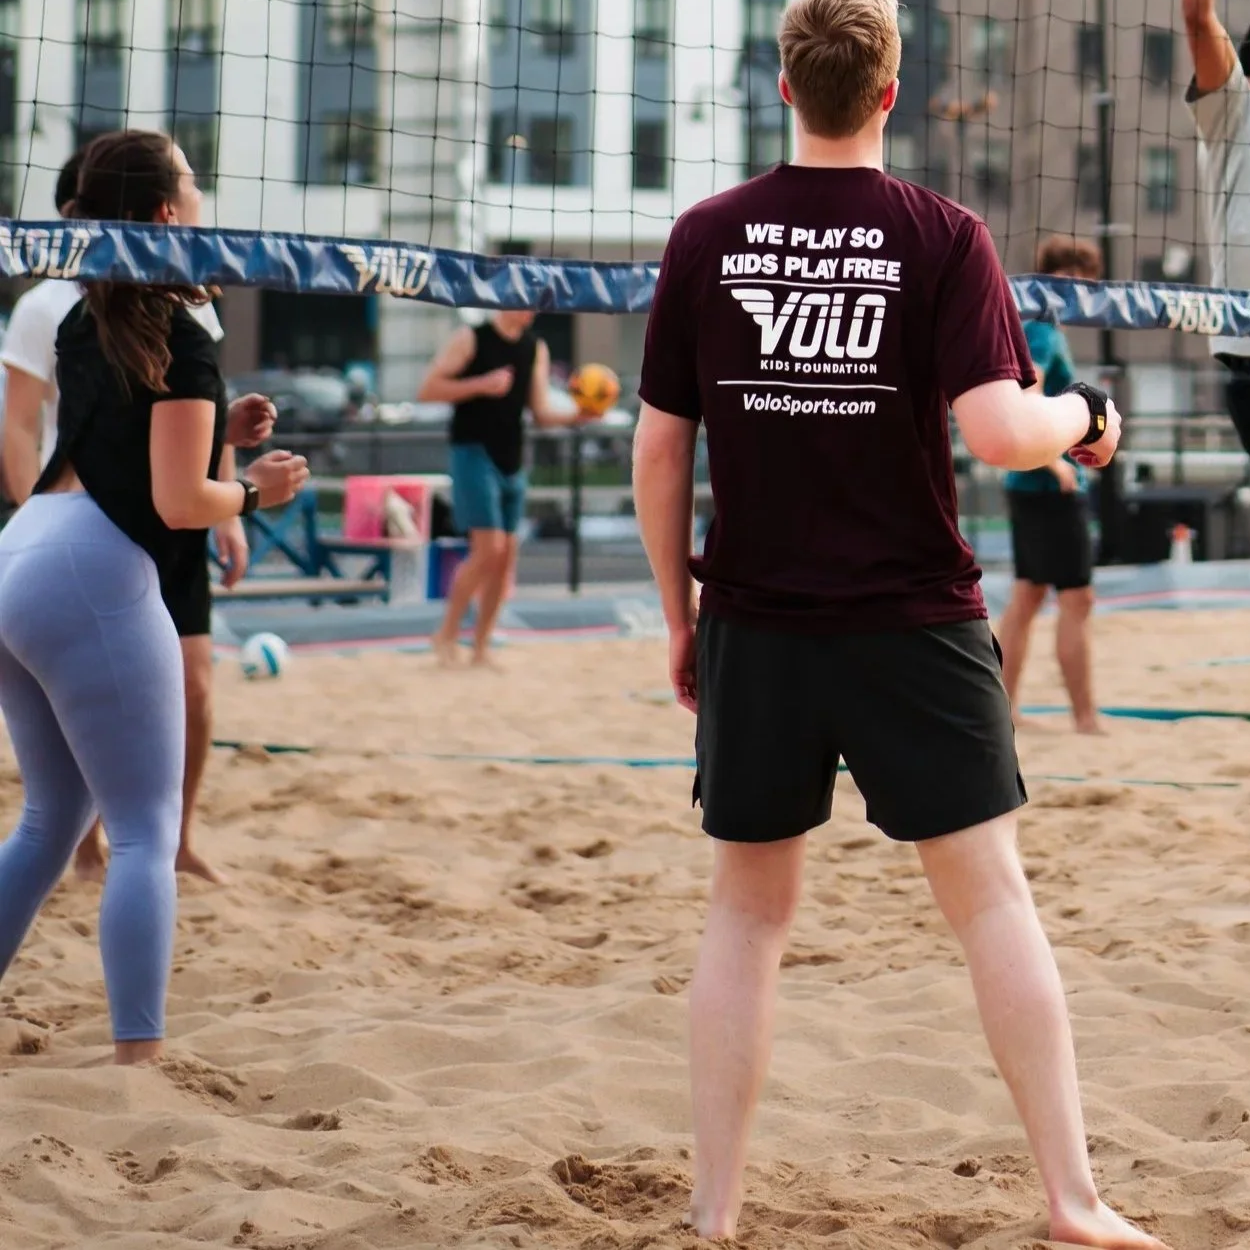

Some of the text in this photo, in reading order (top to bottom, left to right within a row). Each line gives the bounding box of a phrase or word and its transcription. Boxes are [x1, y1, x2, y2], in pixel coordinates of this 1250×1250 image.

[746, 224, 884, 250] WE PLAY SO
[0, 227, 91, 279] VOLO
[337, 244, 434, 297] VOLO
[722, 254, 901, 282] KIDS PLAY FREE
[731, 289, 887, 359] VOLO
[760, 359, 877, 375] KIDS FOUNDATION
[743, 393, 876, 416] VoloSports.com
